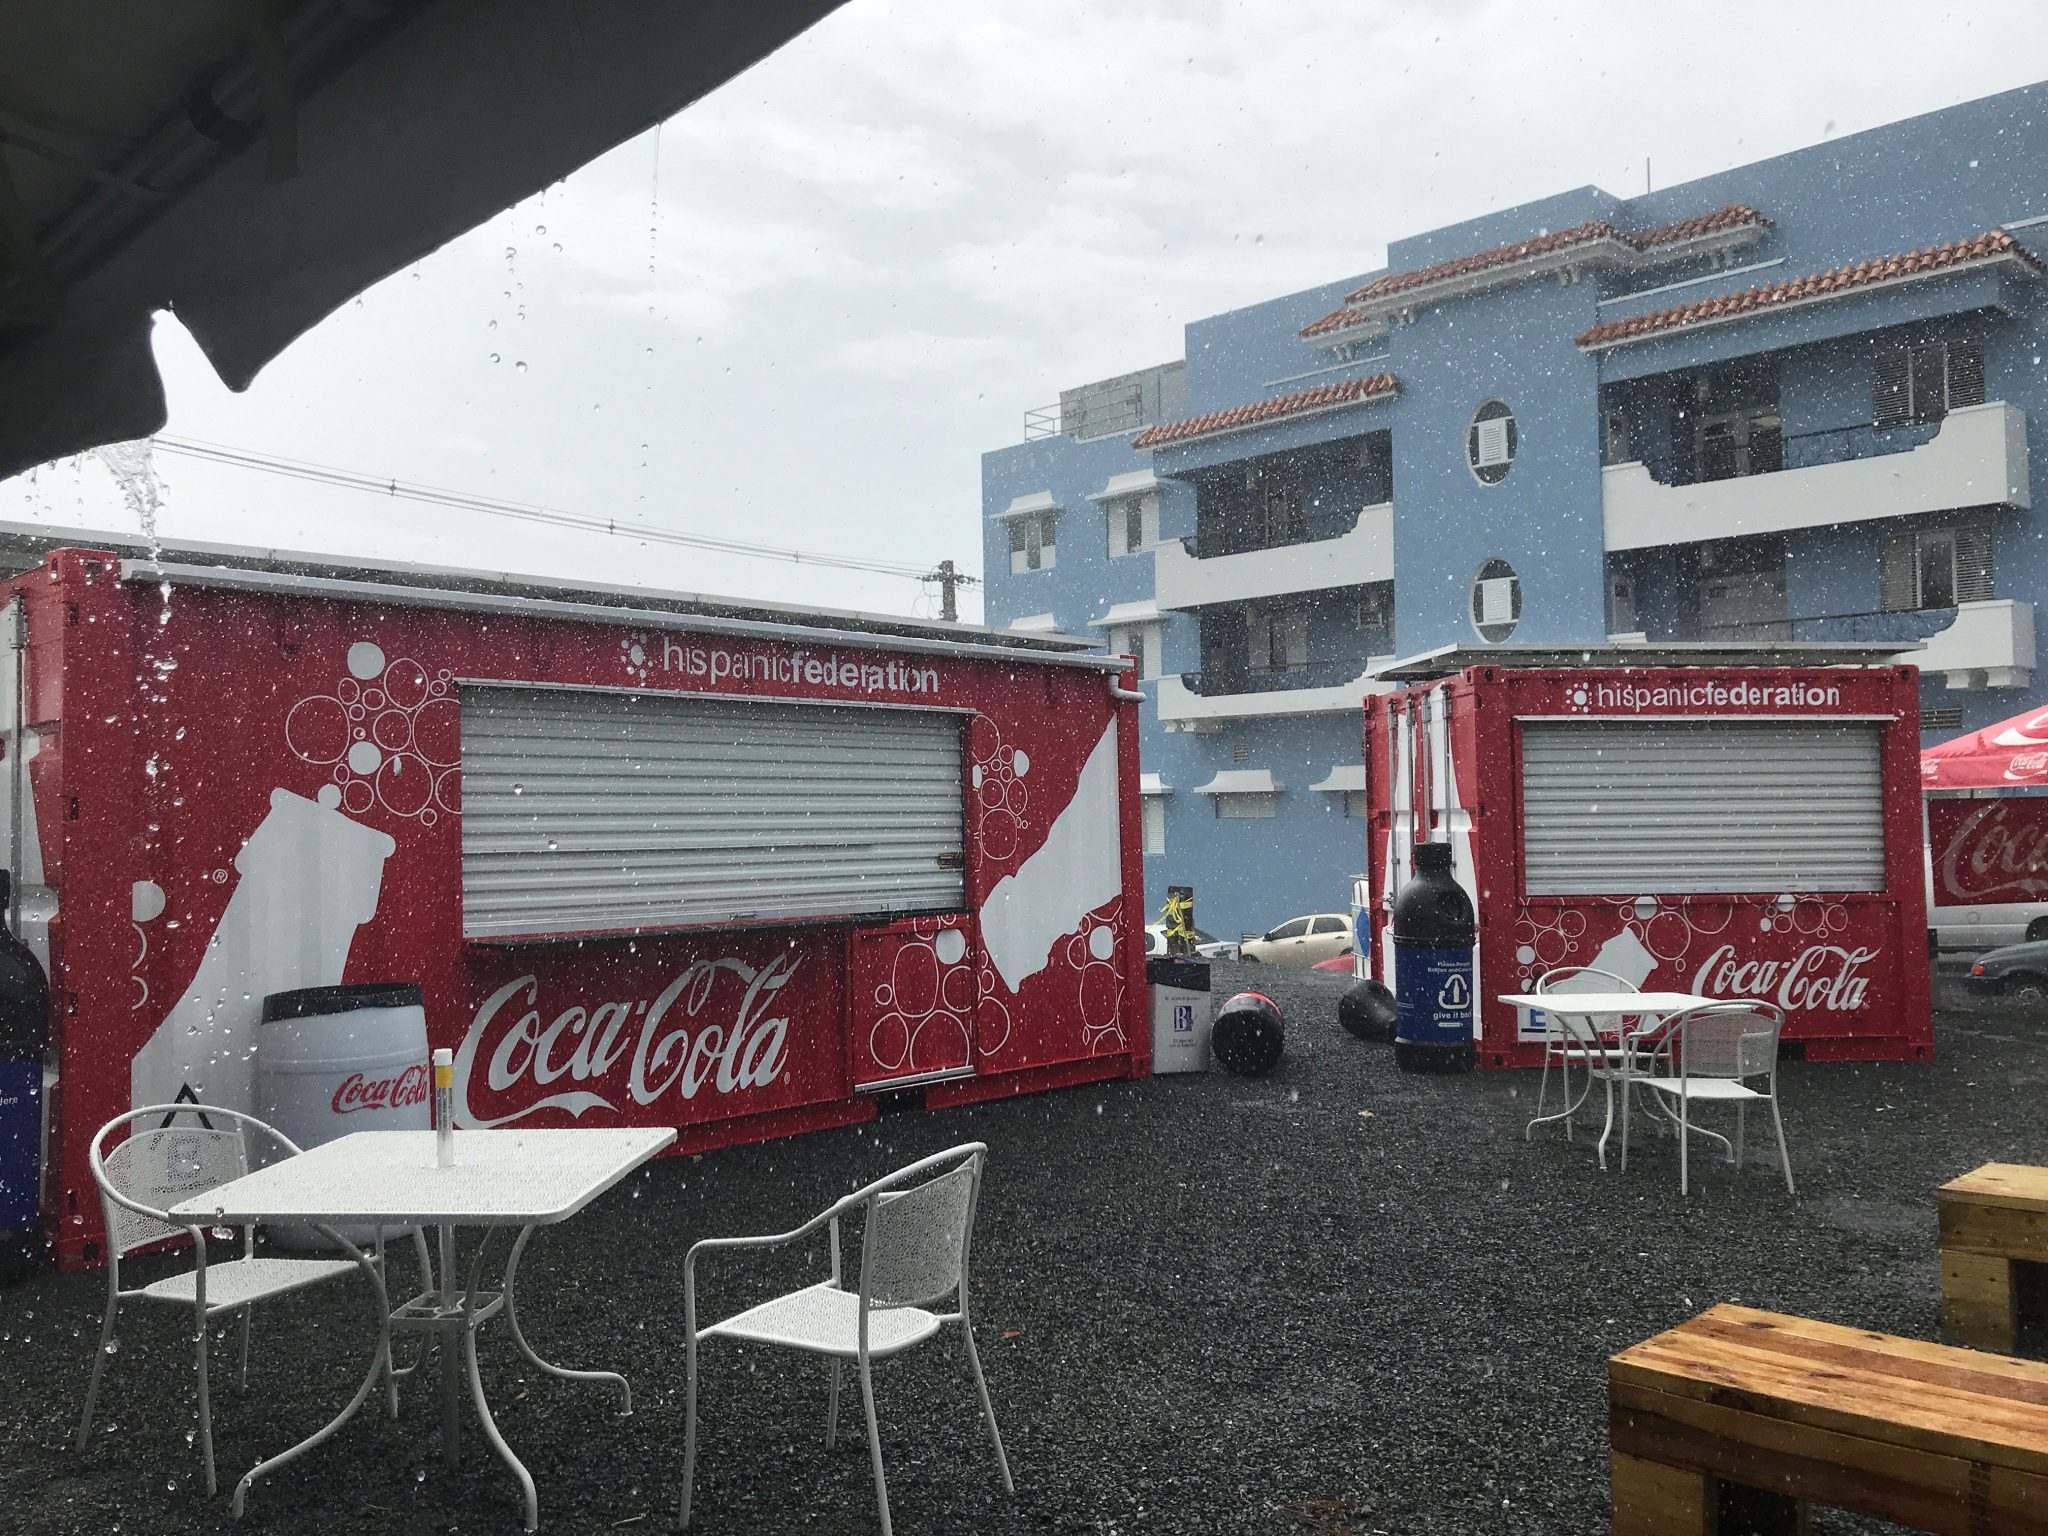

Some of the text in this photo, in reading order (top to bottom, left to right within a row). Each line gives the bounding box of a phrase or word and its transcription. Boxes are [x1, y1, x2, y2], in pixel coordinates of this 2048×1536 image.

[663, 637, 938, 692] hispanicfederation
[1597, 681, 1840, 712] hispanicfederation
[1692, 944, 1882, 1011] Coca-Cola
[452, 951, 804, 1130] Coca-Cola
[1433, 1011, 1451, 1021] give
[1453, 1011, 1459, 1019] it
[331, 1064, 427, 1114] Coca-Cola
